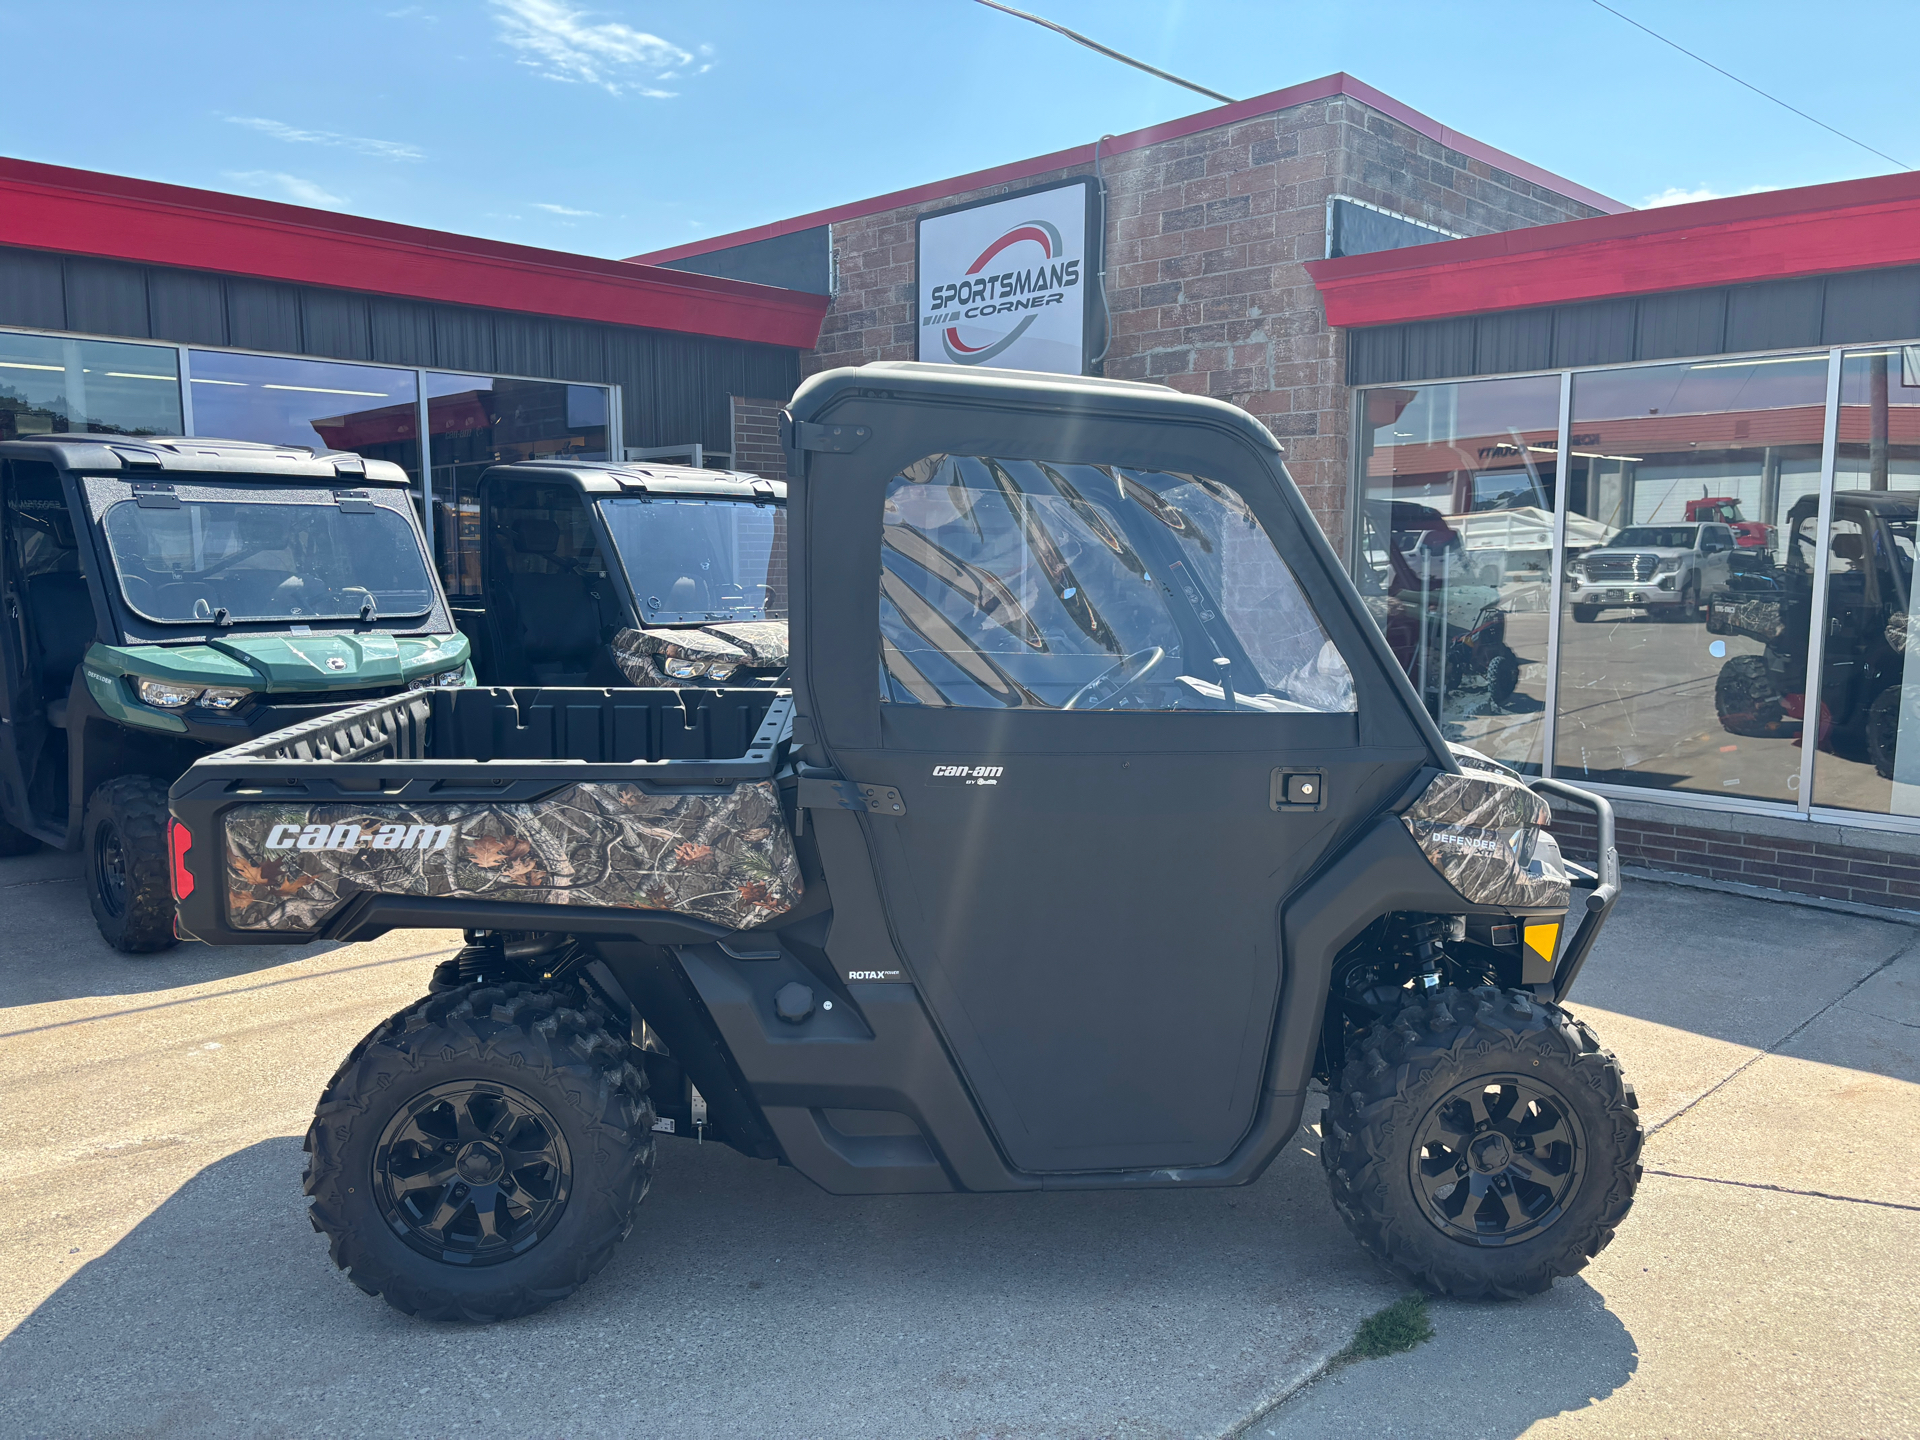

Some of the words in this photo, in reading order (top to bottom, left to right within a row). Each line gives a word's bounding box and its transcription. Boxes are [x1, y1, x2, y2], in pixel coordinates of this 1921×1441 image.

[930, 259, 1081, 311] SPORTSMANS
[964, 292, 1065, 319] CORNER
[87, 670, 112, 685] DEFENDER
[932, 765, 1004, 777] can-am
[265, 824, 453, 849] can-am
[1432, 832, 1497, 851] DEFENDER
[848, 970, 885, 980] ROTAX
